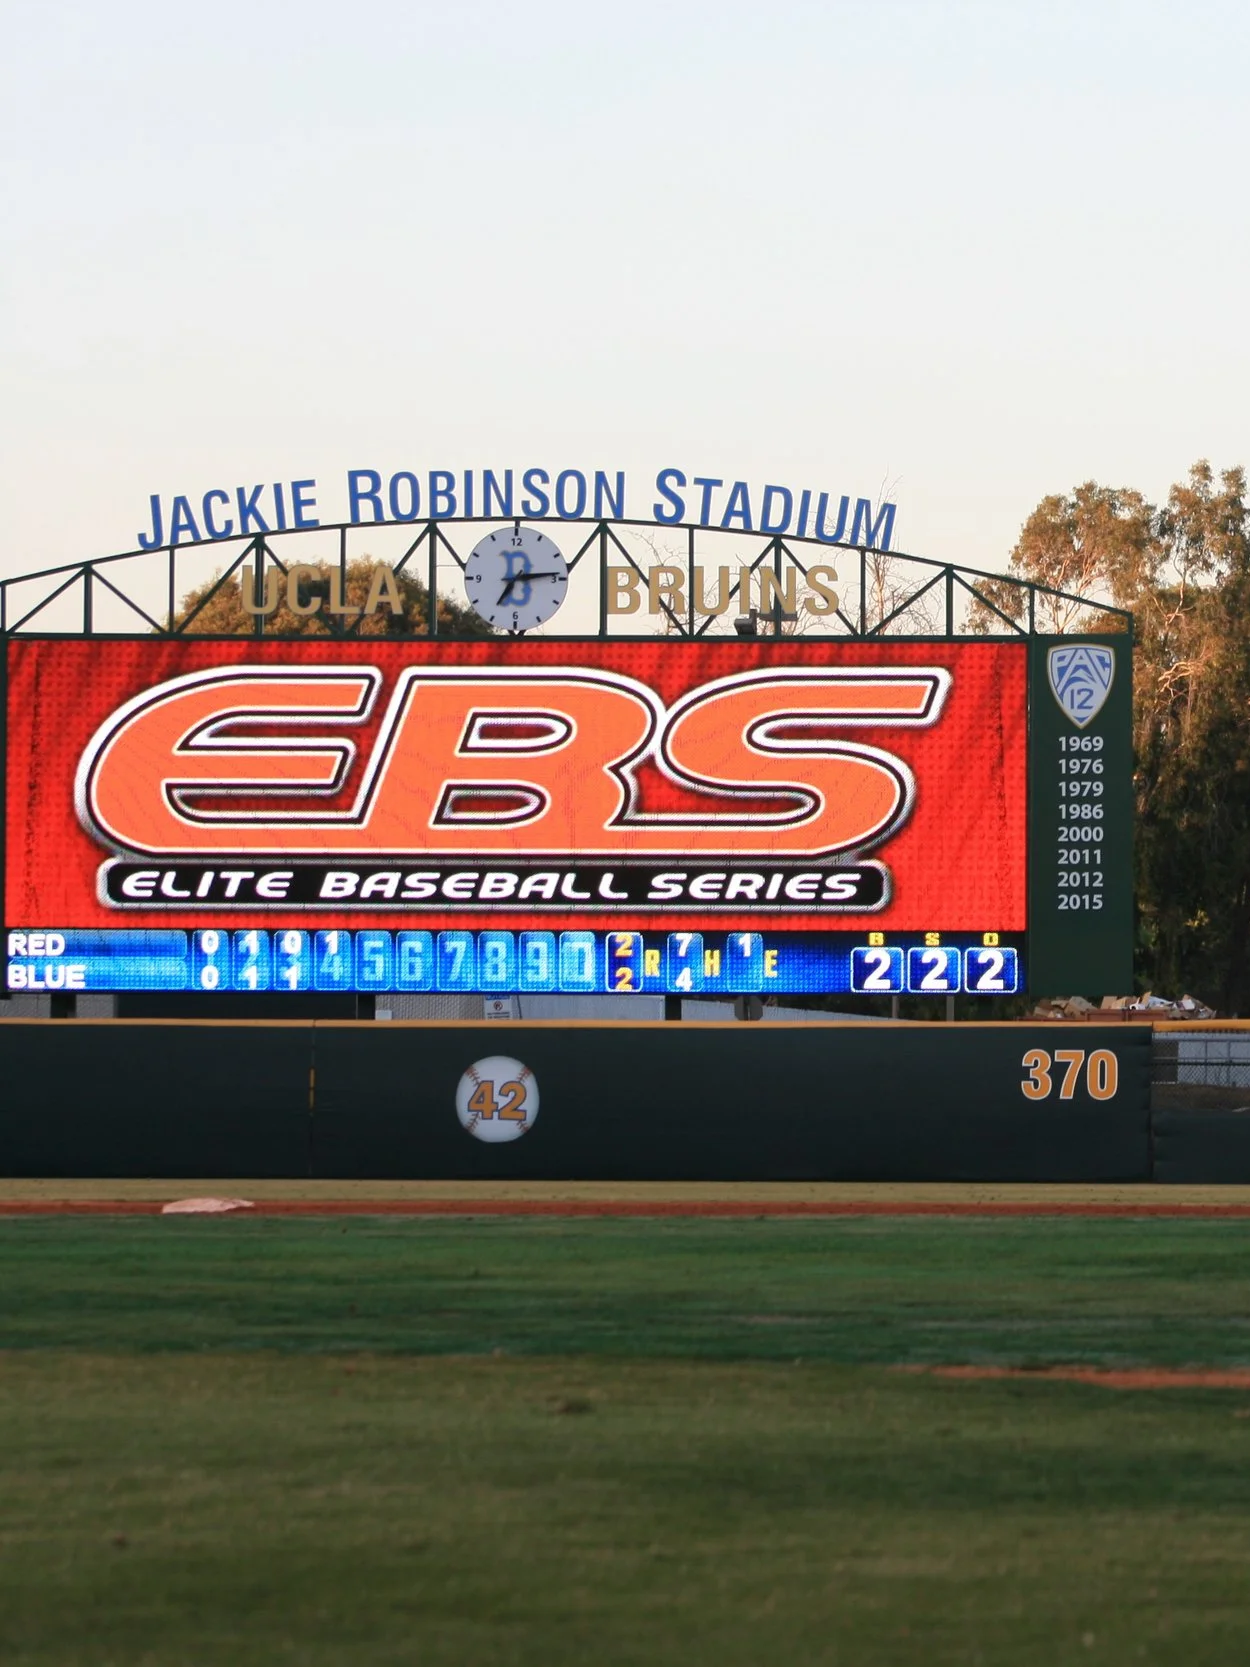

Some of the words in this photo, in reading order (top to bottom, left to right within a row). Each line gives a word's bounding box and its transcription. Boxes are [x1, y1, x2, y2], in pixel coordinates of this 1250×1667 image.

[137, 478, 320, 551] JACKIE
[347, 467, 625, 525] ROBINSON
[653, 468, 897, 552] STADIUM
[511, 538, 523, 546] 12
[241, 565, 403, 616] UCLA
[606, 565, 840, 616] BRUINS
[475, 574, 482, 583] 9
[512, 611, 519, 620] 6
[1070, 688, 1094, 710] 12
[1058, 736, 1104, 752] 1969
[74, 664, 953, 856] EBS
[1058, 759, 1104, 774] 1976
[1058, 781, 1104, 797] 1979
[1058, 804, 1104, 819] 1986
[1057, 826, 1104, 842] 2000
[1057, 849, 1102, 864] 2011
[121, 871, 294, 898] ELITE
[319, 871, 629, 899] BASEBALL
[647, 873, 861, 899] SERIES
[1057, 871, 1104, 887] 2012
[1057, 894, 1103, 910] 2015
[8, 933, 65, 956] RED
[201, 930, 219, 954] 0
[284, 930, 302, 954] 0
[325, 930, 338, 954] 1
[615, 933, 633, 957] 2
[675, 933, 692, 957] 7
[738, 933, 751, 957] 1
[925, 932, 940, 946] S
[363, 941, 384, 982] 5
[400, 941, 423, 982] 6
[444, 941, 467, 982] 7
[484, 941, 507, 982] 8
[526, 941, 548, 982] 9
[645, 950, 660, 977] R
[704, 950, 721, 977] H
[764, 950, 778, 977] E
[864, 949, 891, 989] 2
[920, 949, 948, 989] 2
[976, 949, 1004, 989] 2
[7, 964, 86, 988] BLUE
[201, 965, 219, 989] 0
[615, 967, 633, 991] 2
[675, 967, 693, 991] 4
[1021, 1049, 1118, 1100] 370
[467, 1080, 528, 1121] 42
